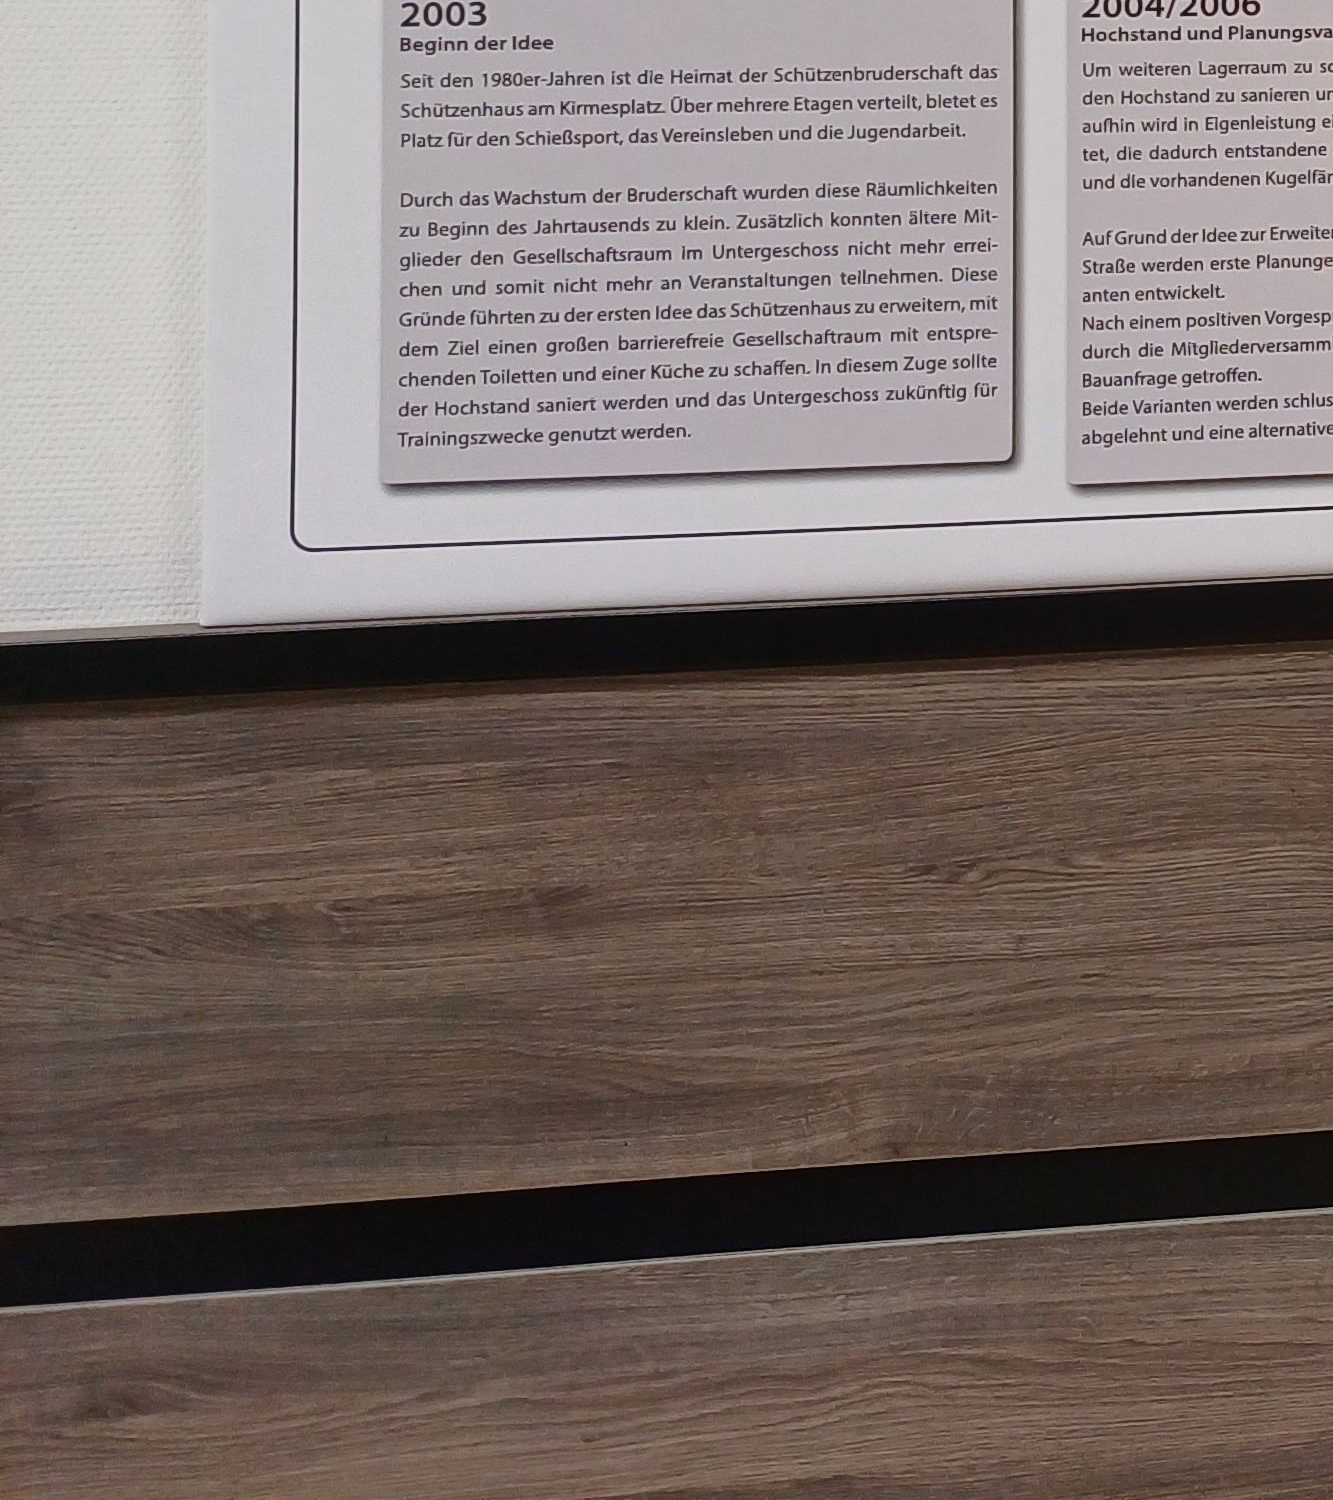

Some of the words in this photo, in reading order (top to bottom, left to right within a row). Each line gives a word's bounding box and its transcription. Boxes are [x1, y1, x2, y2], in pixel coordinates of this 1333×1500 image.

[400, 1, 488, 27] 2003
[1081, 25, 1182, 42] Hochstand
[1186, 24, 1223, 40] und
[399, 36, 469, 55] Beginn
[473, 35, 508, 50] der
[511, 34, 554, 50] Idee
[399, 73, 435, 88] Seit
[439, 72, 474, 87] den
[482, 70, 605, 87] 1980er-Jahren
[611, 70, 632, 85] ist
[636, 69, 665, 84] die
[670, 68, 734, 84] Heimat
[738, 67, 769, 83] der
[773, 63, 964, 82] Schützenbruderschaft
[968, 63, 999, 79] das
[1082, 62, 1112, 77] Um
[1118, 61, 1192, 76] weiteren
[1198, 60, 1287, 78] Lagerraum
[1293, 62, 1313, 73] zu
[1082, 89, 1115, 105] den
[1120, 87, 1210, 104] Hochstand
[1215, 91, 1235, 102] zu
[1240, 87, 1310, 102] sanieren
[400, 191, 454, 207] Durch
[459, 190, 490, 206] das
[493, 189, 587, 205] Wachstum
[592, 187, 623, 203] der
[627, 184, 738, 202] Bruderschaft
[742, 183, 810, 200] wurden
[815, 182, 861, 198] diese
[866, 179, 998, 196] Räumlichkeiten
[1082, 288, 1130, 302] anten
[1134, 283, 1226, 301] entwickelt.
[1082, 370, 1178, 389] Bauanfrage
[1181, 366, 1263, 387] getroffen.
[396, 427, 544, 449] Trainingszwecke
[548, 426, 618, 446] genutzt
[620, 422, 692, 439] werden.
